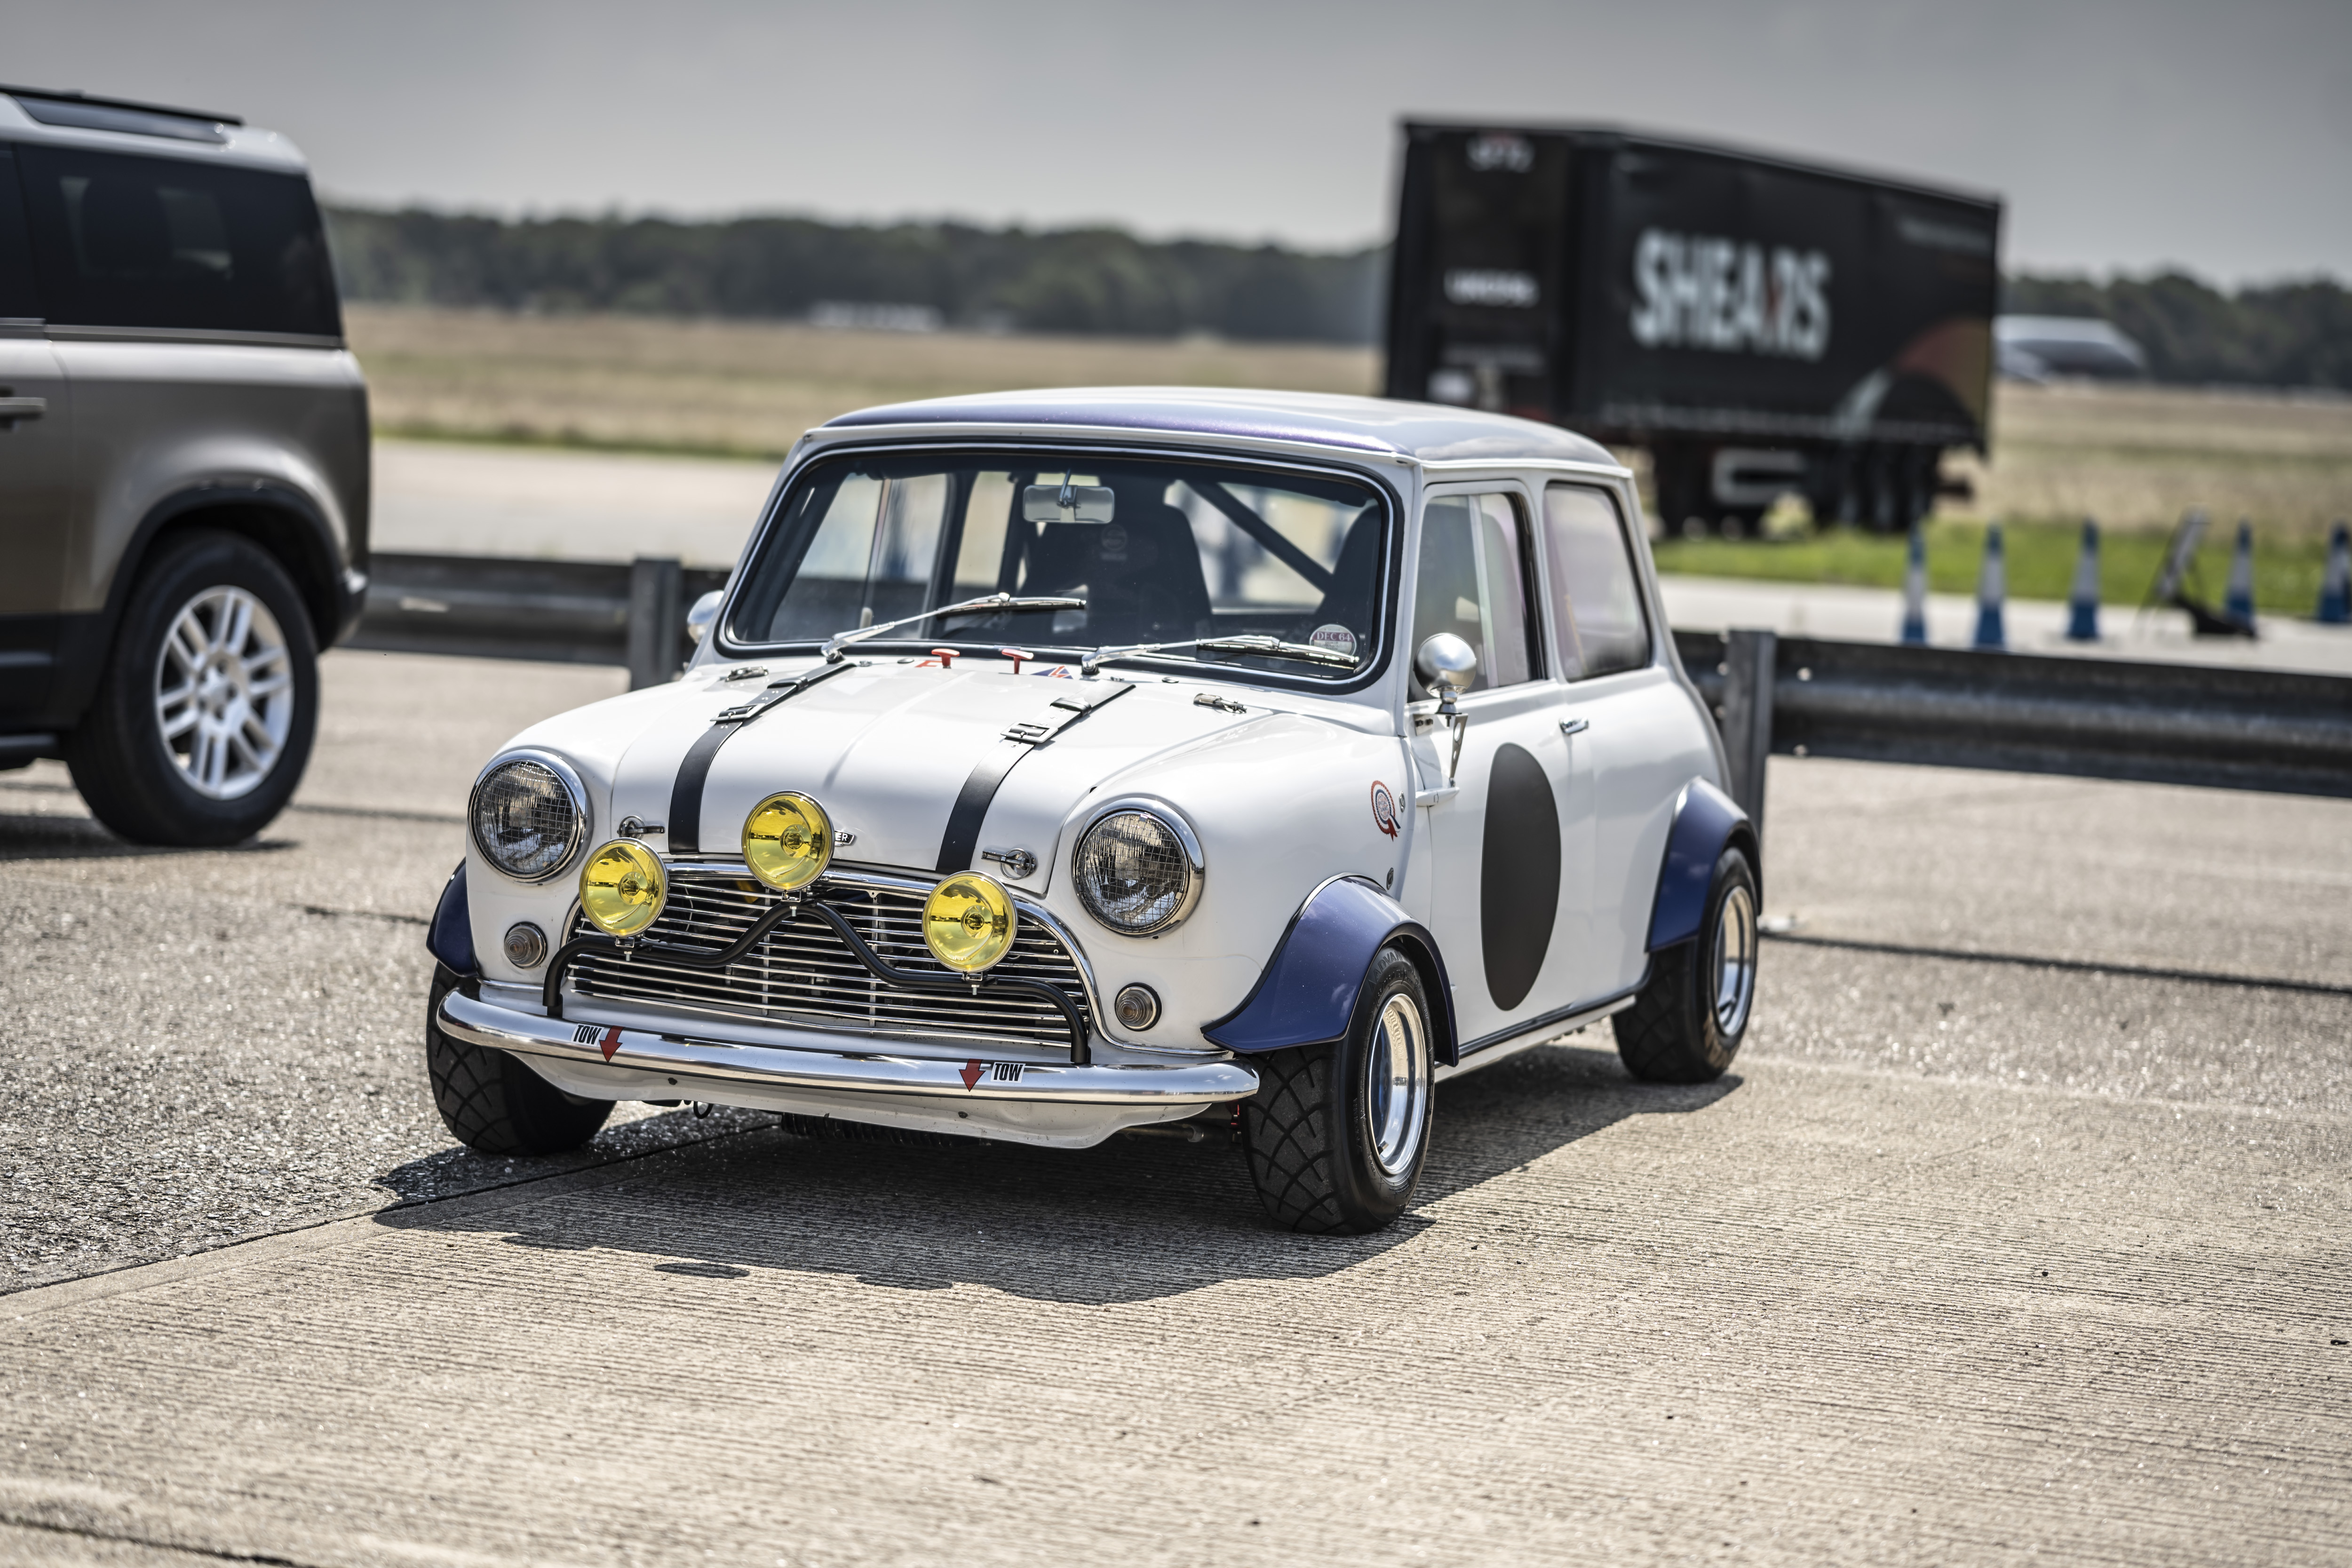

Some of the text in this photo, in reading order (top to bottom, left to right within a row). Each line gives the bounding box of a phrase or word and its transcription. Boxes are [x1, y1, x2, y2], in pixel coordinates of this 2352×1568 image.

[1632, 228, 1830, 361] SHEARS
[1317, 632, 1351, 641] DEC 64
[1374, 950, 1403, 983] ADVAN
[573, 1025, 602, 1045] TOW
[993, 1063, 1024, 1082] TOW
